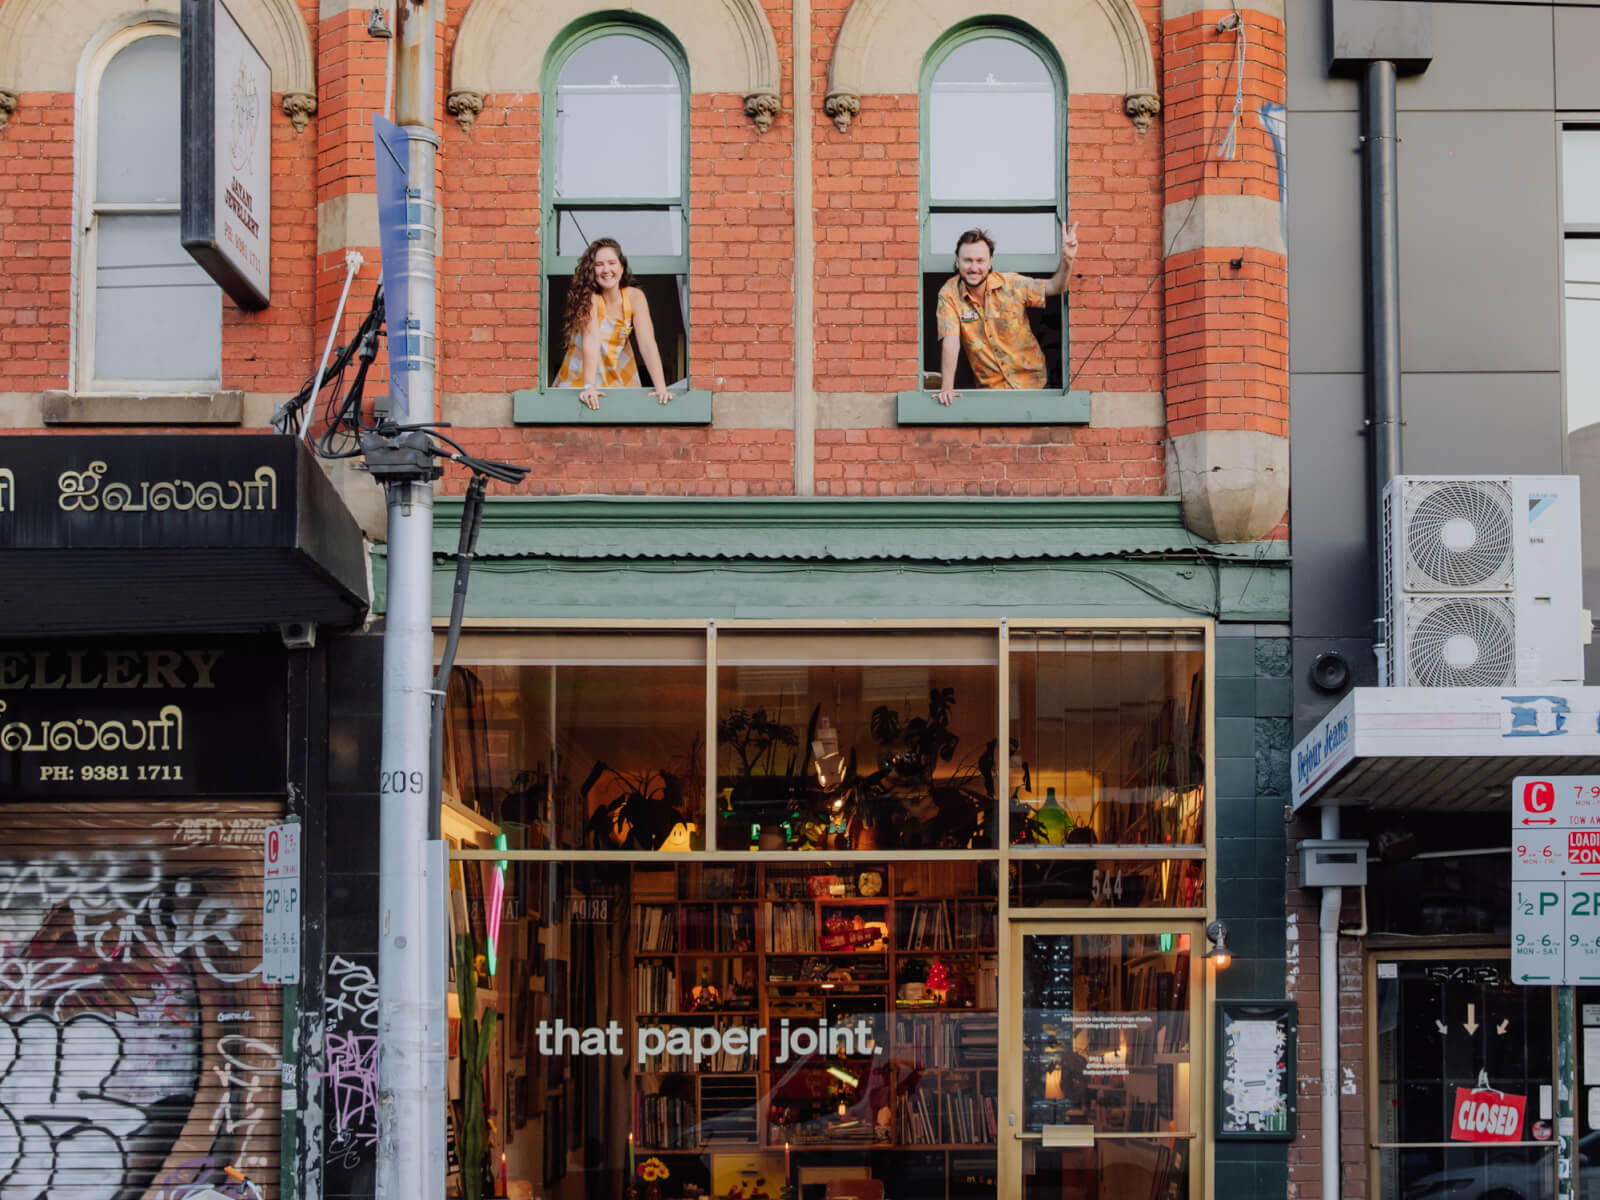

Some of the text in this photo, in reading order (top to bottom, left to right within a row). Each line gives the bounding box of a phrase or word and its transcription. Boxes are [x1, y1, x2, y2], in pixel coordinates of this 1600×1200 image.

[224, 189, 260, 240] JEWELLERY
[0, 699, 183, 752] வல்லரி
[1324, 716, 1348, 758] Jeans
[40, 766, 183, 780] PH: 9381 1711
[382, 770, 424, 794] 209
[1570, 816, 1586, 825] TOW
[266, 889, 280, 914] 2P
[1090, 868, 1124, 901] 544
[536, 1018, 882, 1064] that paper joint.
[1458, 1100, 1519, 1136] CLOSED
